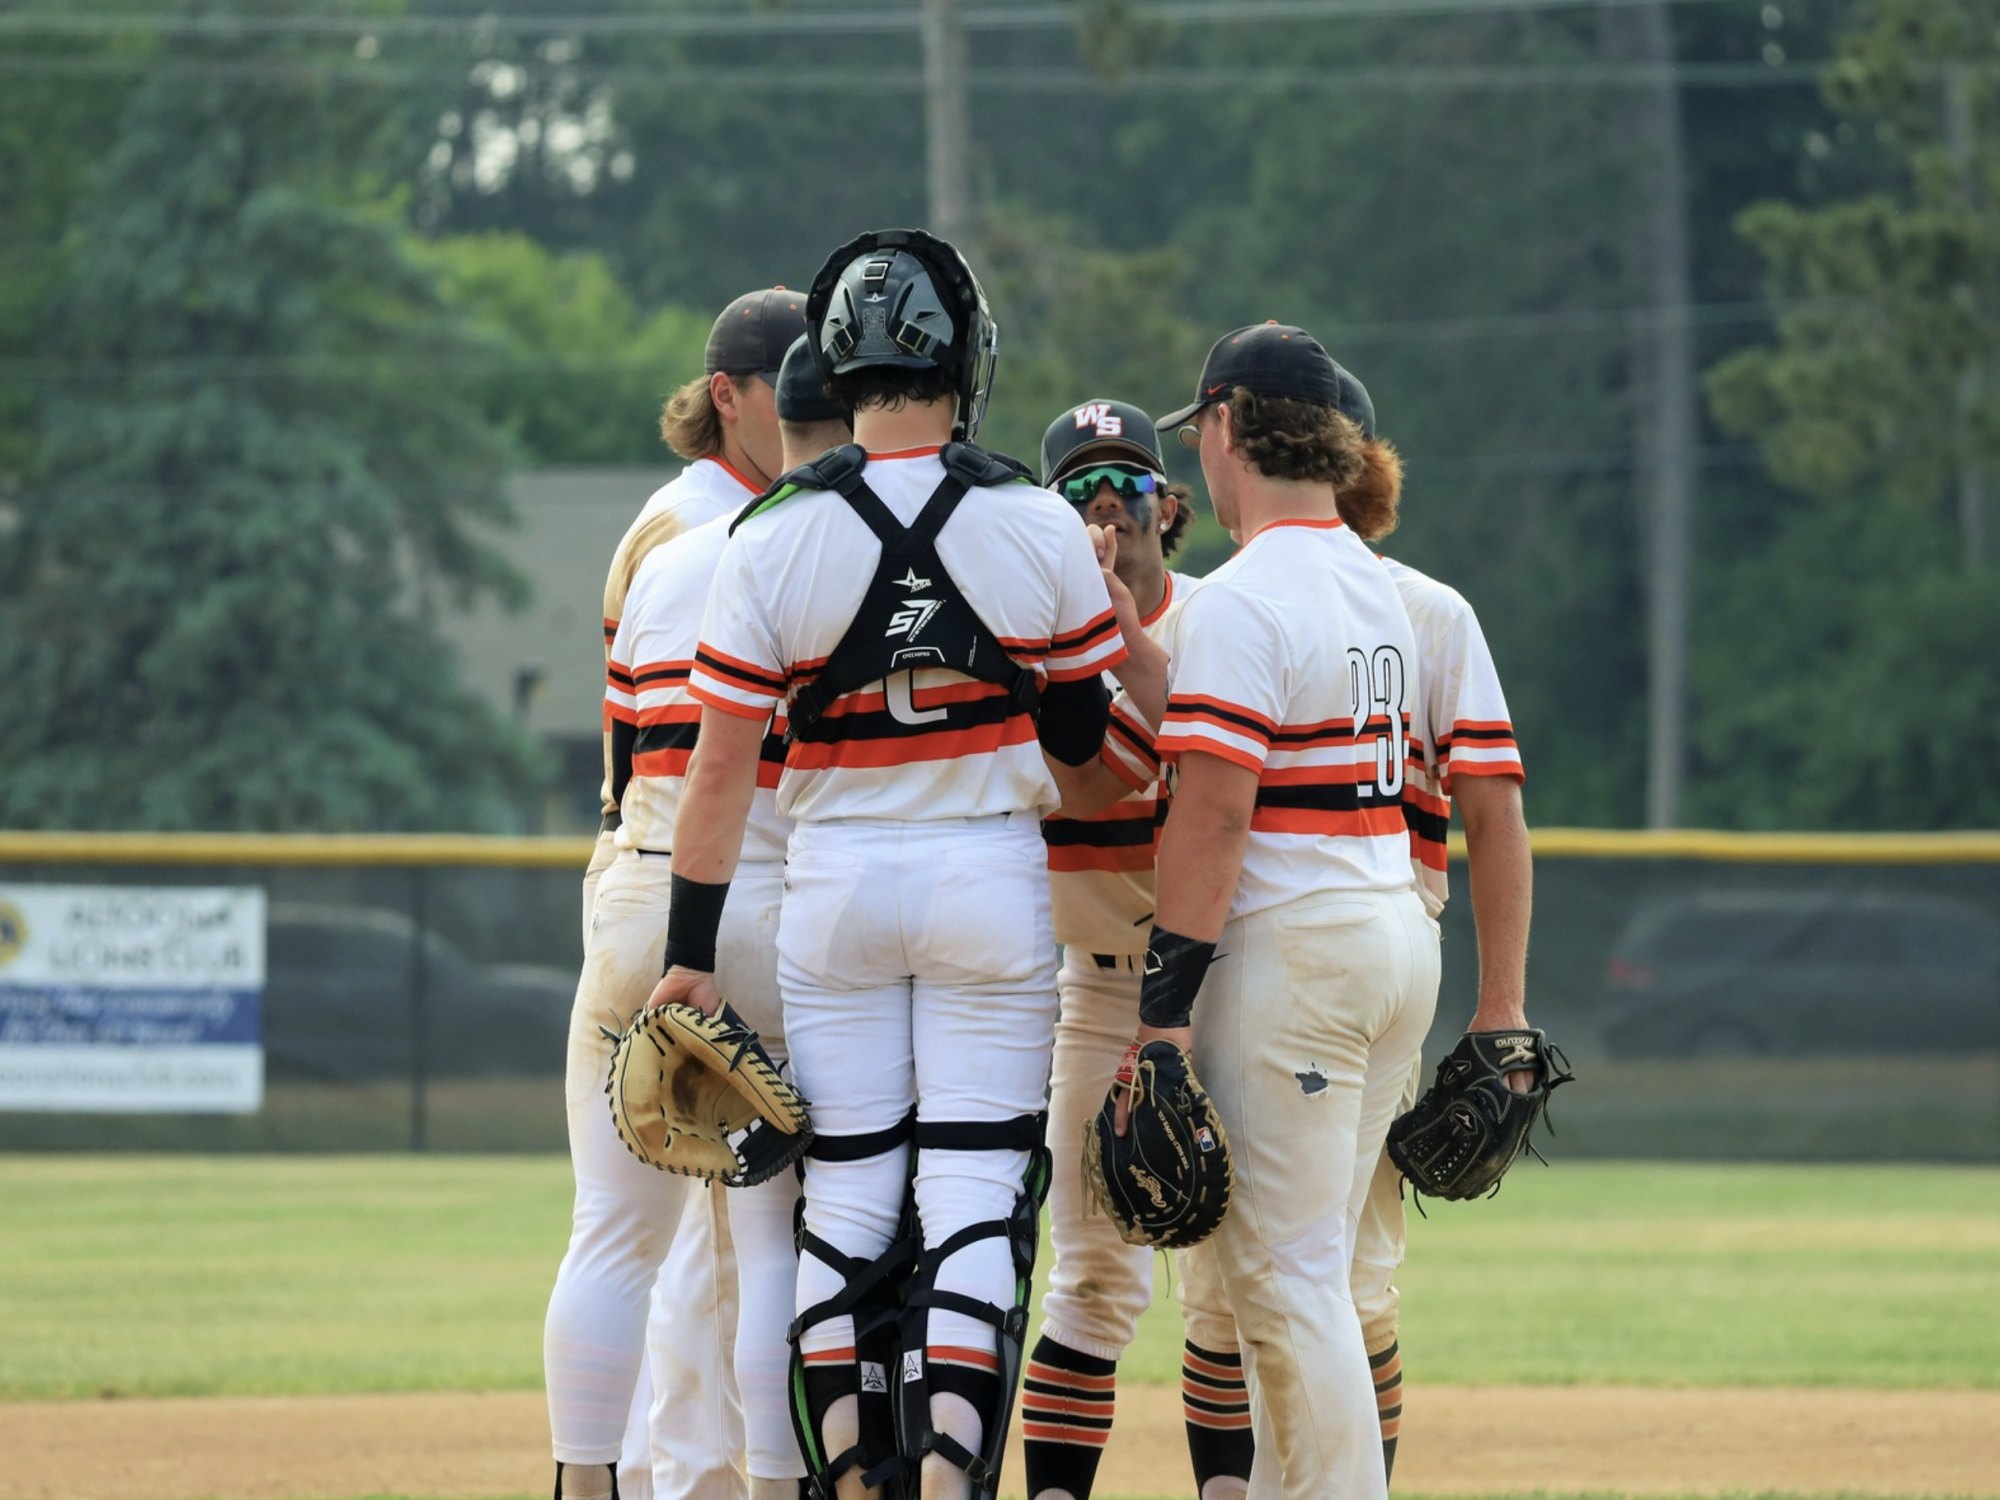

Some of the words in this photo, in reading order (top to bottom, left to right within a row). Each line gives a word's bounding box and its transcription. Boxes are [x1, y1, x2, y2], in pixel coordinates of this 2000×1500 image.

[1073, 404, 1122, 437] WS
[885, 599, 938, 641] S7
[1347, 644, 1404, 797] 23
[1494, 1037, 1533, 1048] MIZUNO
